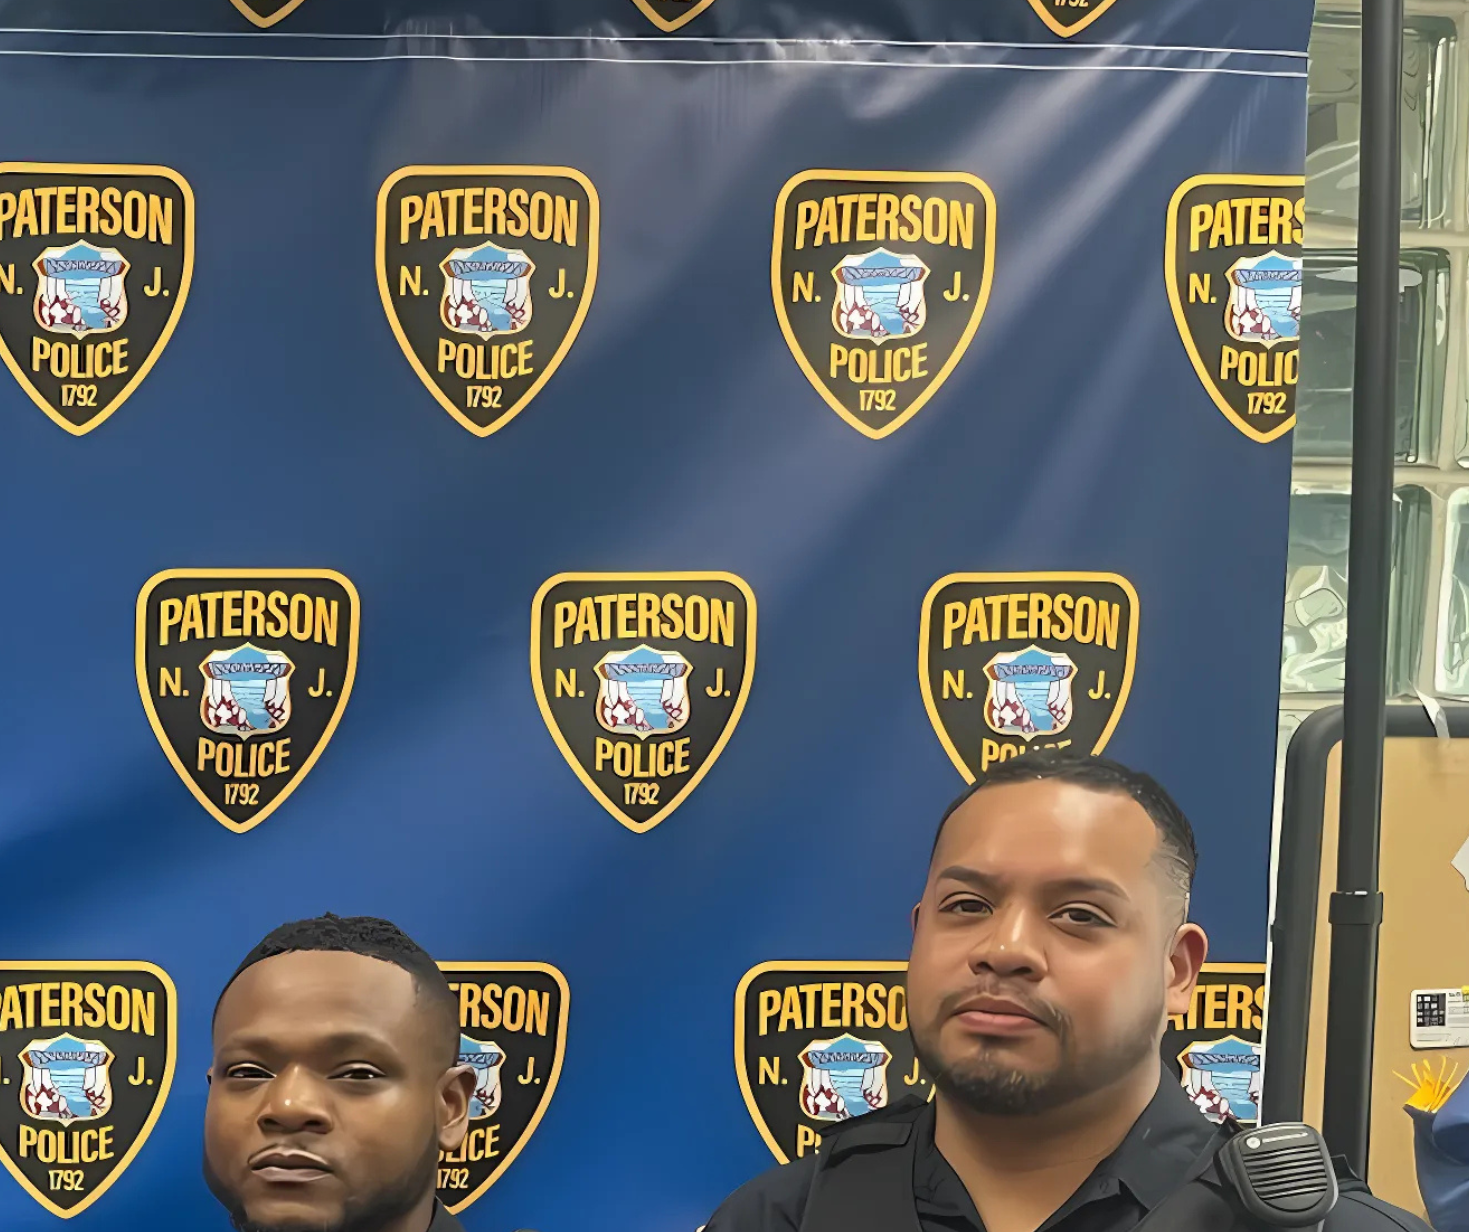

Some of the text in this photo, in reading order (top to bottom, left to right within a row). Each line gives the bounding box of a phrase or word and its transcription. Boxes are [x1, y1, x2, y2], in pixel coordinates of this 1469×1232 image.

[400, 187, 579, 247] PATERSON
[795, 193, 975, 250] PATERSON
[144, 267, 169, 296] J.
[400, 265, 574, 299] N. J.
[793, 271, 969, 302] N. J.
[1188, 273, 1217, 304] N.
[32, 336, 129, 379] POLICE
[437, 337, 534, 380] POLICE
[830, 342, 928, 384] POLICE
[61, 384, 98, 407] 1792
[466, 385, 502, 408] 1792
[859, 388, 896, 411] 1792
[1247, 391, 1287, 414] 1792
[160, 590, 339, 647] PATERSON
[554, 592, 735, 648] PATERSON
[943, 593, 1120, 650] PATERSON
[160, 667, 332, 697] N. J.
[555, 668, 730, 697] N. J.
[942, 669, 1111, 699] N. J.
[198, 737, 291, 778] POLICE
[595, 736, 691, 778] POLICE
[225, 783, 259, 805] 1792
[624, 782, 660, 805] 1792
[128, 1057, 153, 1085] J.
[517, 1056, 541, 1084] J.
[758, 1056, 927, 1085] N. J.
[19, 1124, 115, 1164] POLICE
[49, 1169, 85, 1190] 1792
